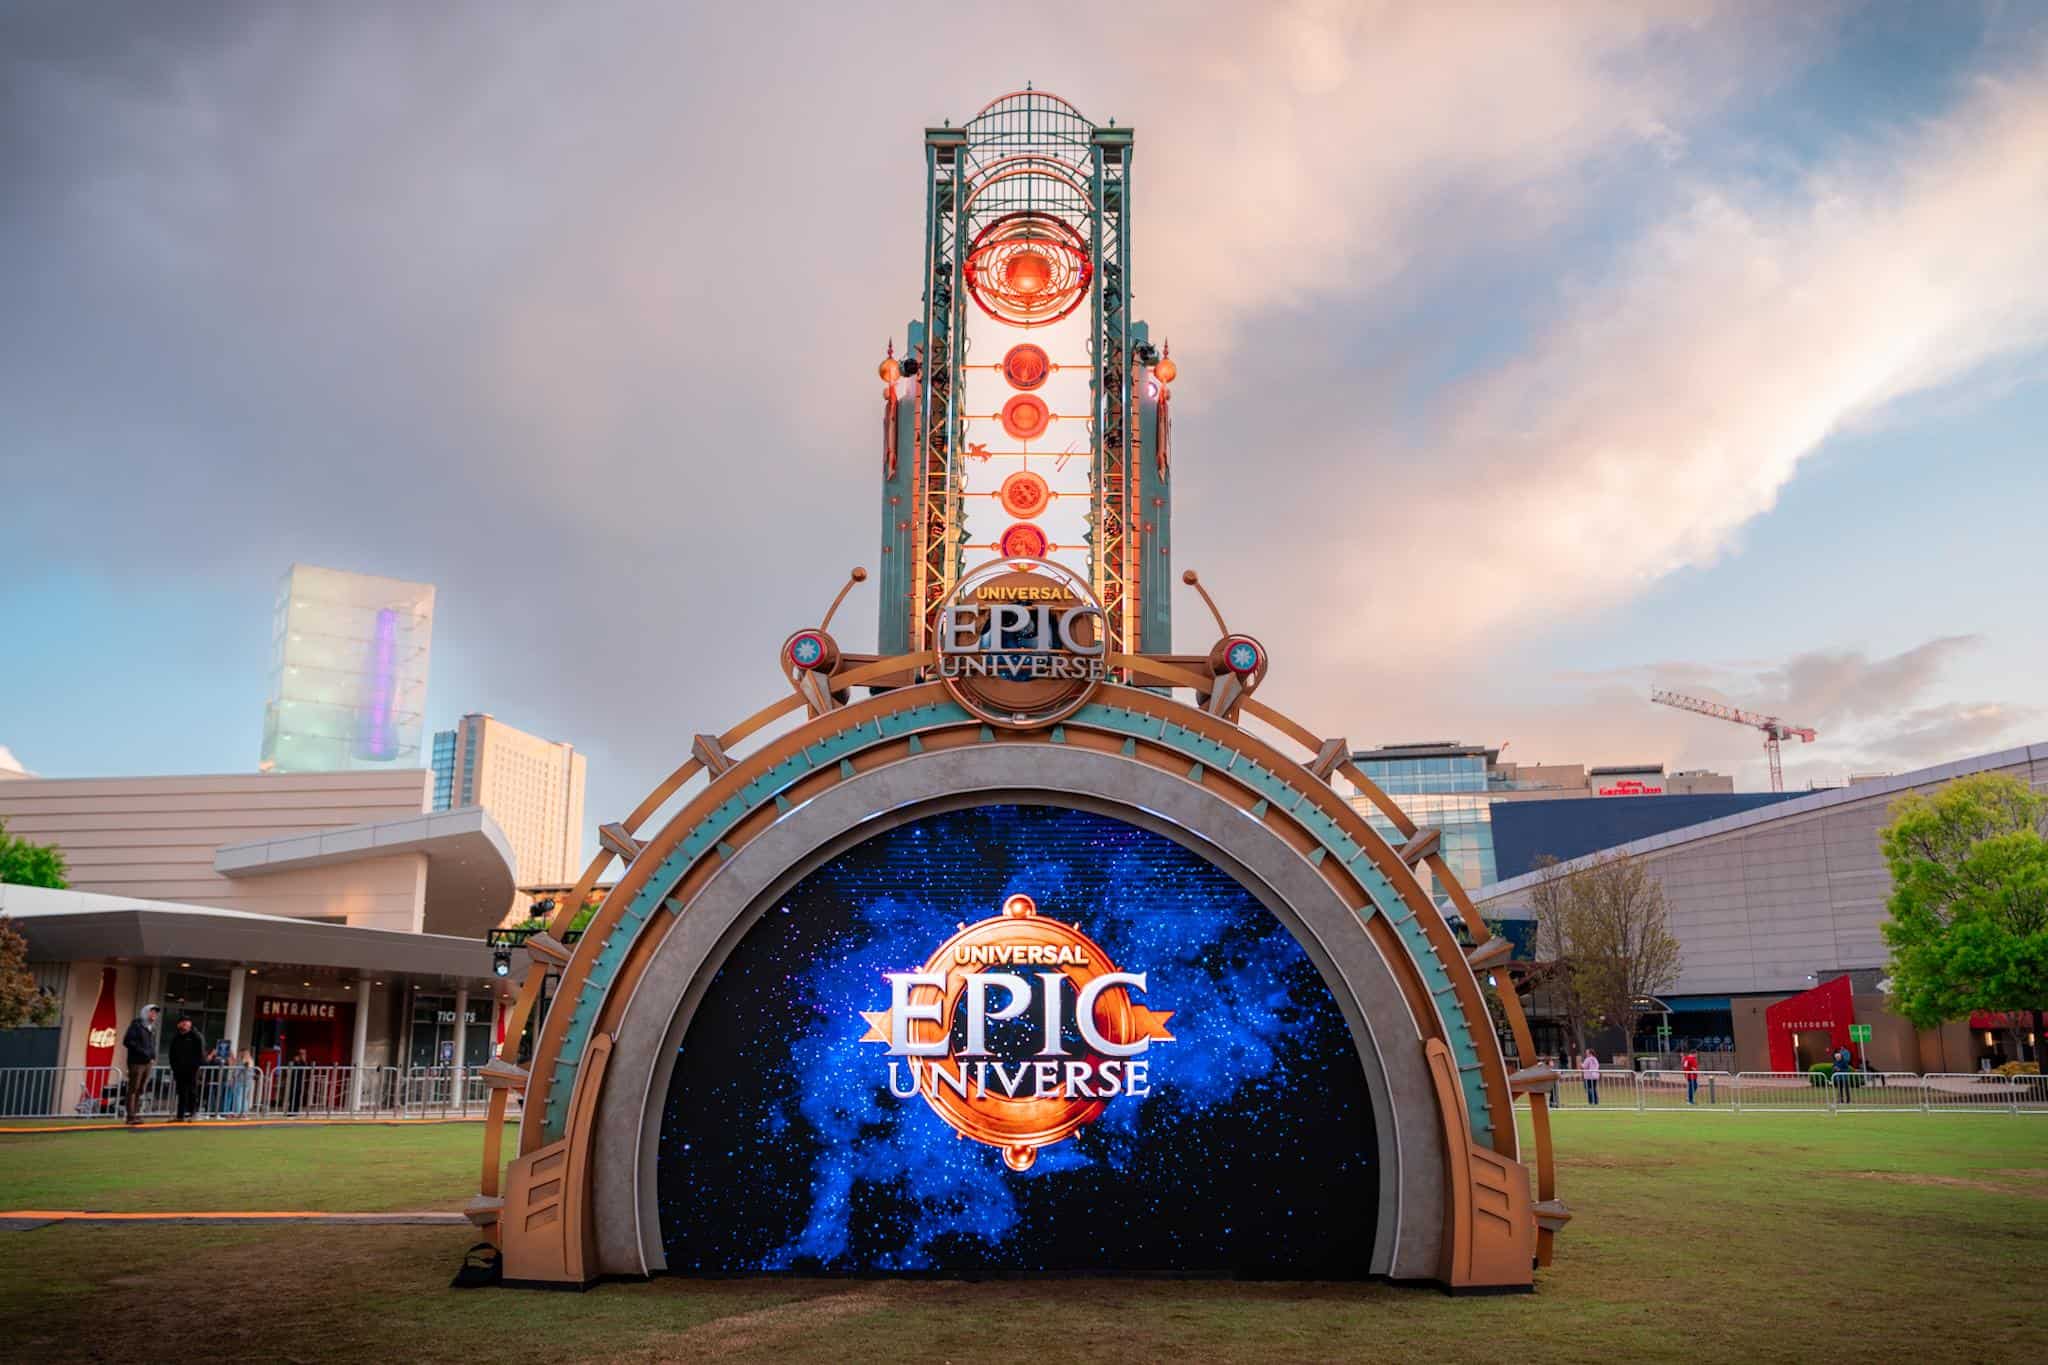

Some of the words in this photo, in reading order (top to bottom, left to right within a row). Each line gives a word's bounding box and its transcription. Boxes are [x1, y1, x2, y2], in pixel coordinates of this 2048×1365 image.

[976, 586, 1074, 600] UNIVERSAL
[942, 602, 1105, 655] EPIC
[940, 655, 1106, 680] UNIVERSE
[954, 945, 1090, 965] UNIVERSAL
[262, 1000, 336, 1018] ENTRANCE
[436, 1010, 477, 1023] TICTS
[882, 971, 1151, 1057] EPIC
[887, 1060, 1152, 1099] UNIVERSE
